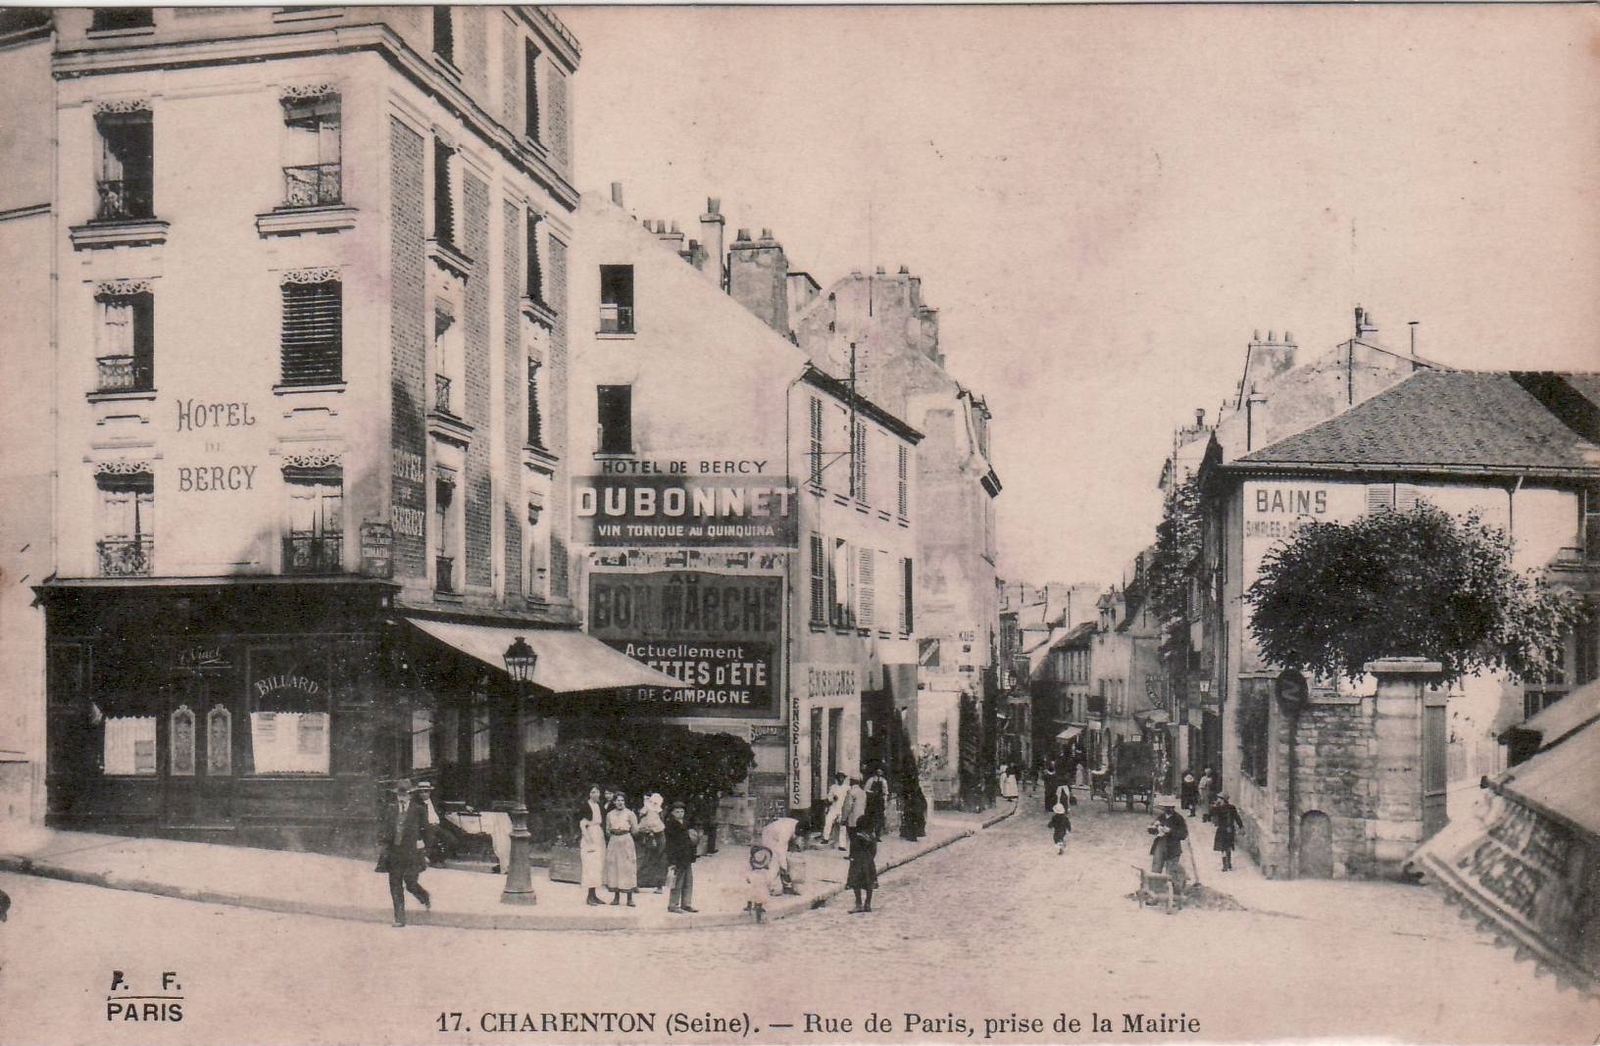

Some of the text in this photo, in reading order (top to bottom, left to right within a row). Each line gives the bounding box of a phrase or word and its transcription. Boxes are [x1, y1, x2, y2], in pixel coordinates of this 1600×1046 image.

[176, 398, 256, 432] HOTEL
[178, 465, 258, 492] BERCY
[602, 460, 768, 474] HOTEL DE BERCY
[575, 486, 796, 518] DUBONNET
[1256, 489, 1327, 513] BAINS
[391, 505, 425, 537] BERCY
[598, 524, 775, 539] VIN TONIQUE AU QUINQUINA
[669, 573, 699, 584] AU
[625, 643, 745, 659] Actuellement
[254, 674, 319, 698] BILLARD
[638, 688, 656, 702] DE
[662, 689, 751, 704] CAMPAGNE
